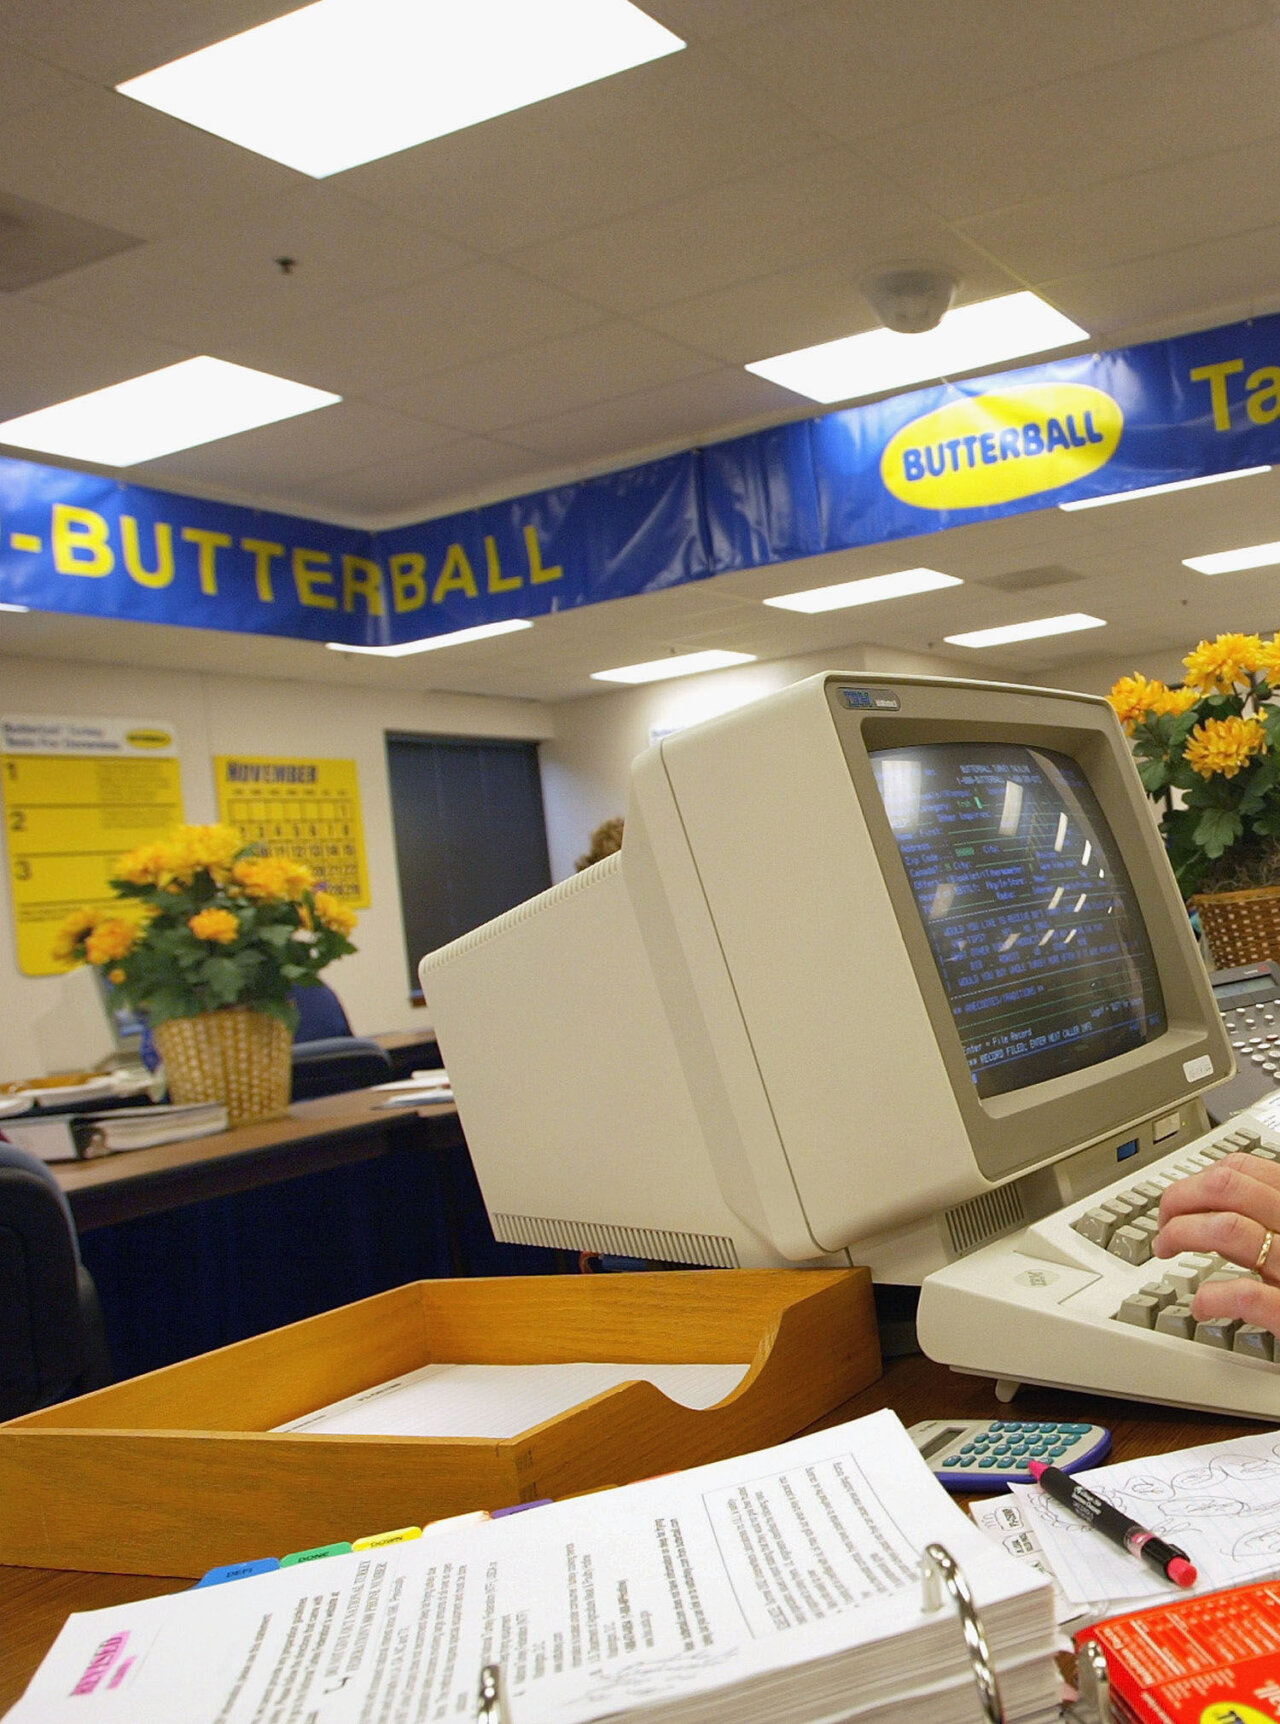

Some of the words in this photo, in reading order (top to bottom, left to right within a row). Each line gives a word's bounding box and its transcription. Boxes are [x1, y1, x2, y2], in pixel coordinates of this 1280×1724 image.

[903, 410, 1104, 482] BUTTERBALL
[7, 762, 18, 781] 1
[227, 761, 318, 784] NOVEMBER
[9, 811, 26, 832] 2
[15, 861, 32, 880] 3
